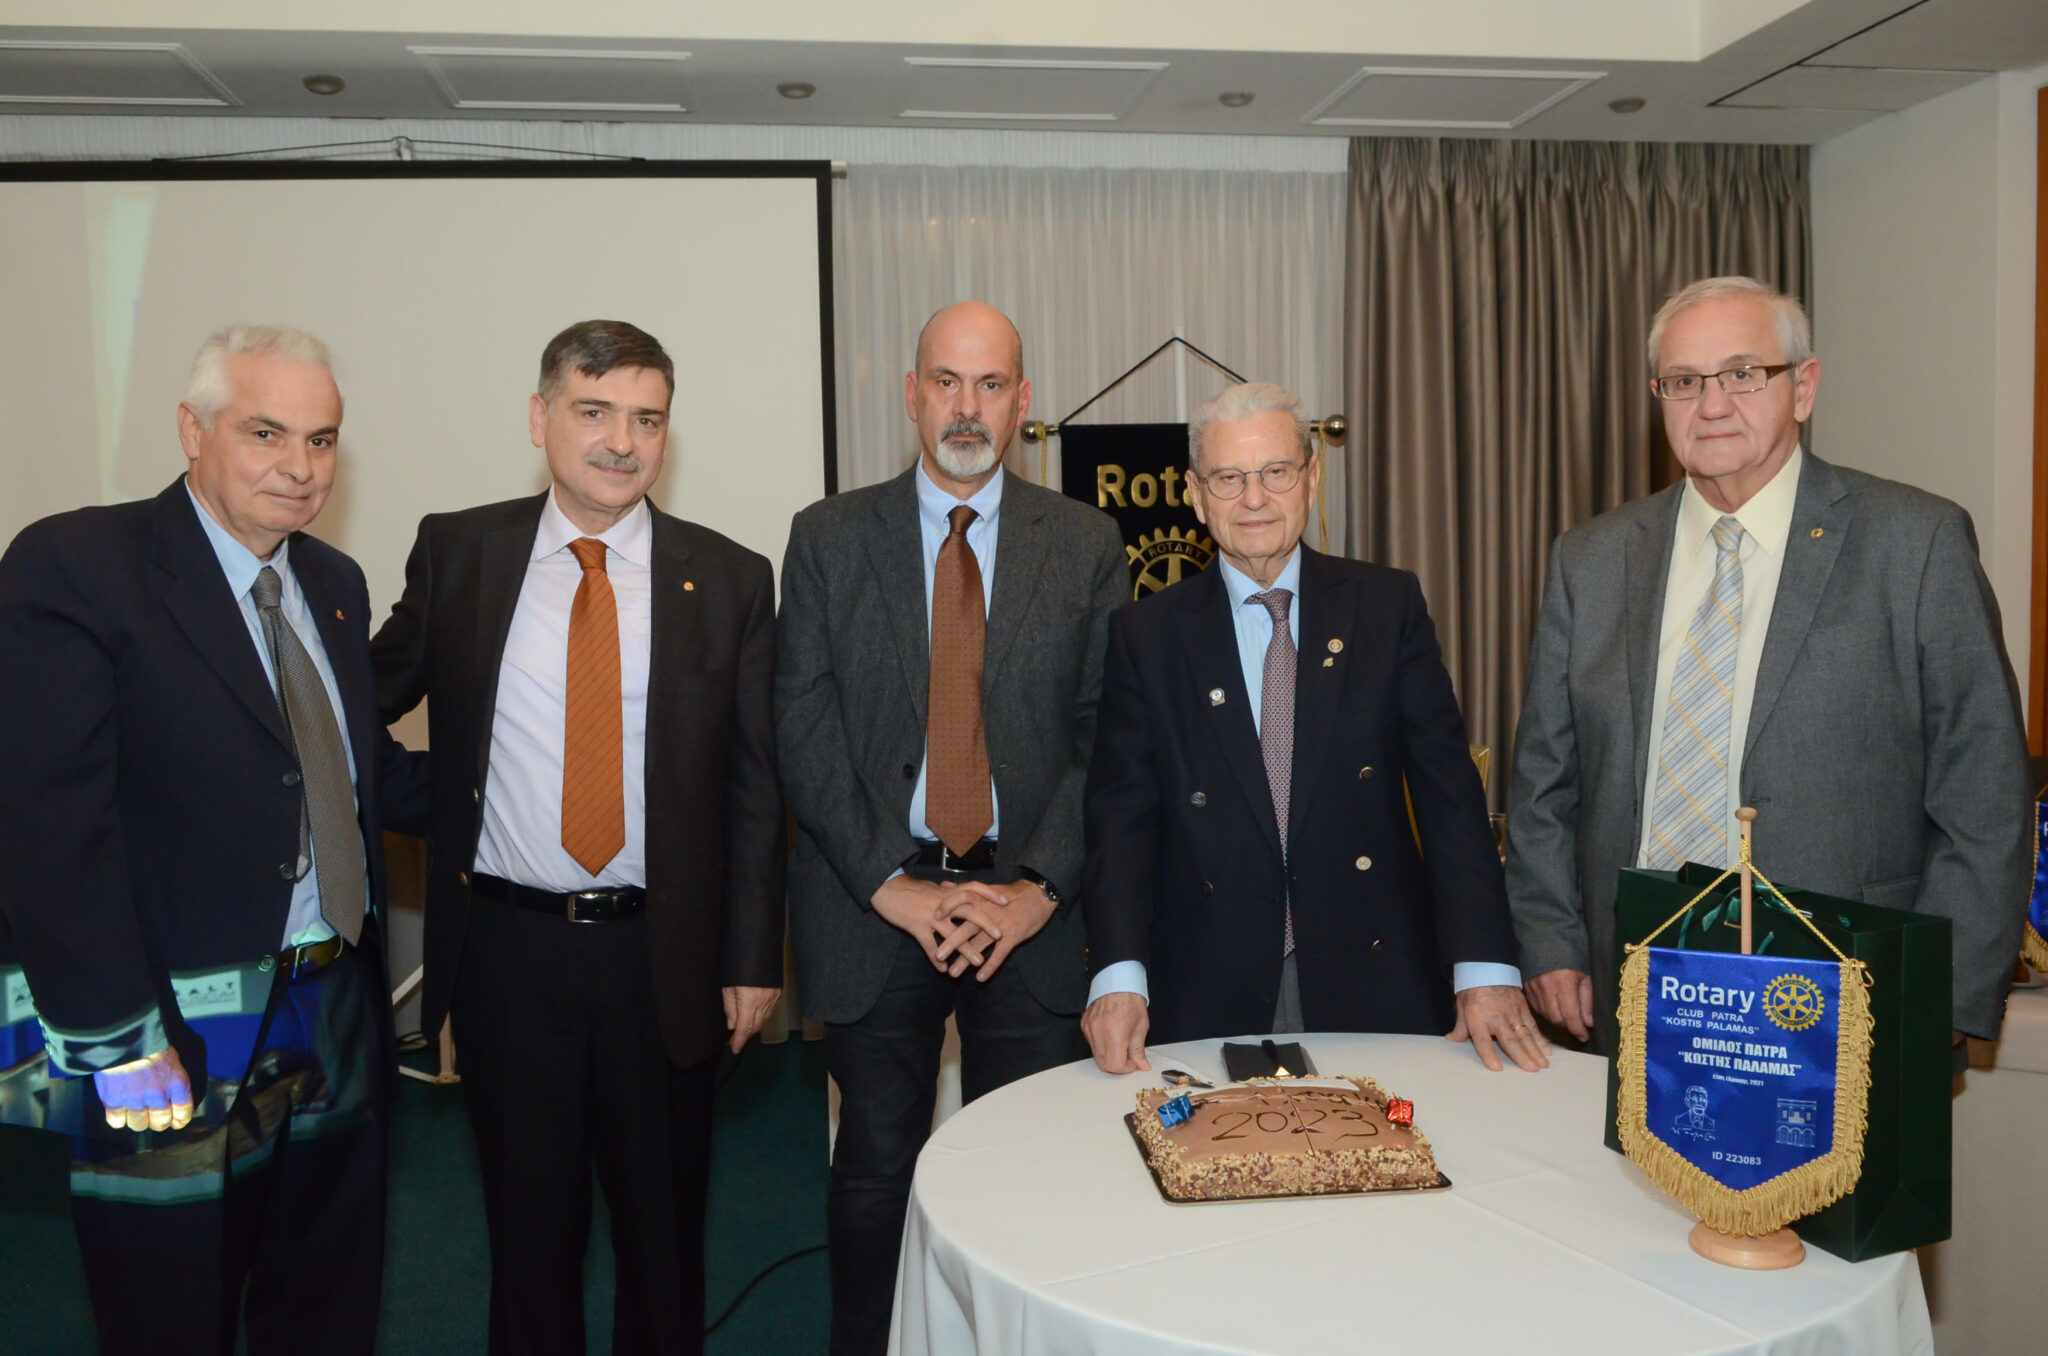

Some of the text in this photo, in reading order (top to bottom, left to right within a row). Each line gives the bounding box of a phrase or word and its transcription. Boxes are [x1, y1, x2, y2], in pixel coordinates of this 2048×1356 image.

[1661, 976, 1755, 1014] Rotary
[1676, 1008, 1744, 1023] CLUB PATRA
[1692, 1037, 1788, 1059] ΟΜΙΛΟΣ ΠΑΤΡΑ
[1211, 1109, 1379, 1142] 2023
[1712, 1151, 1762, 1166] ID 223083
